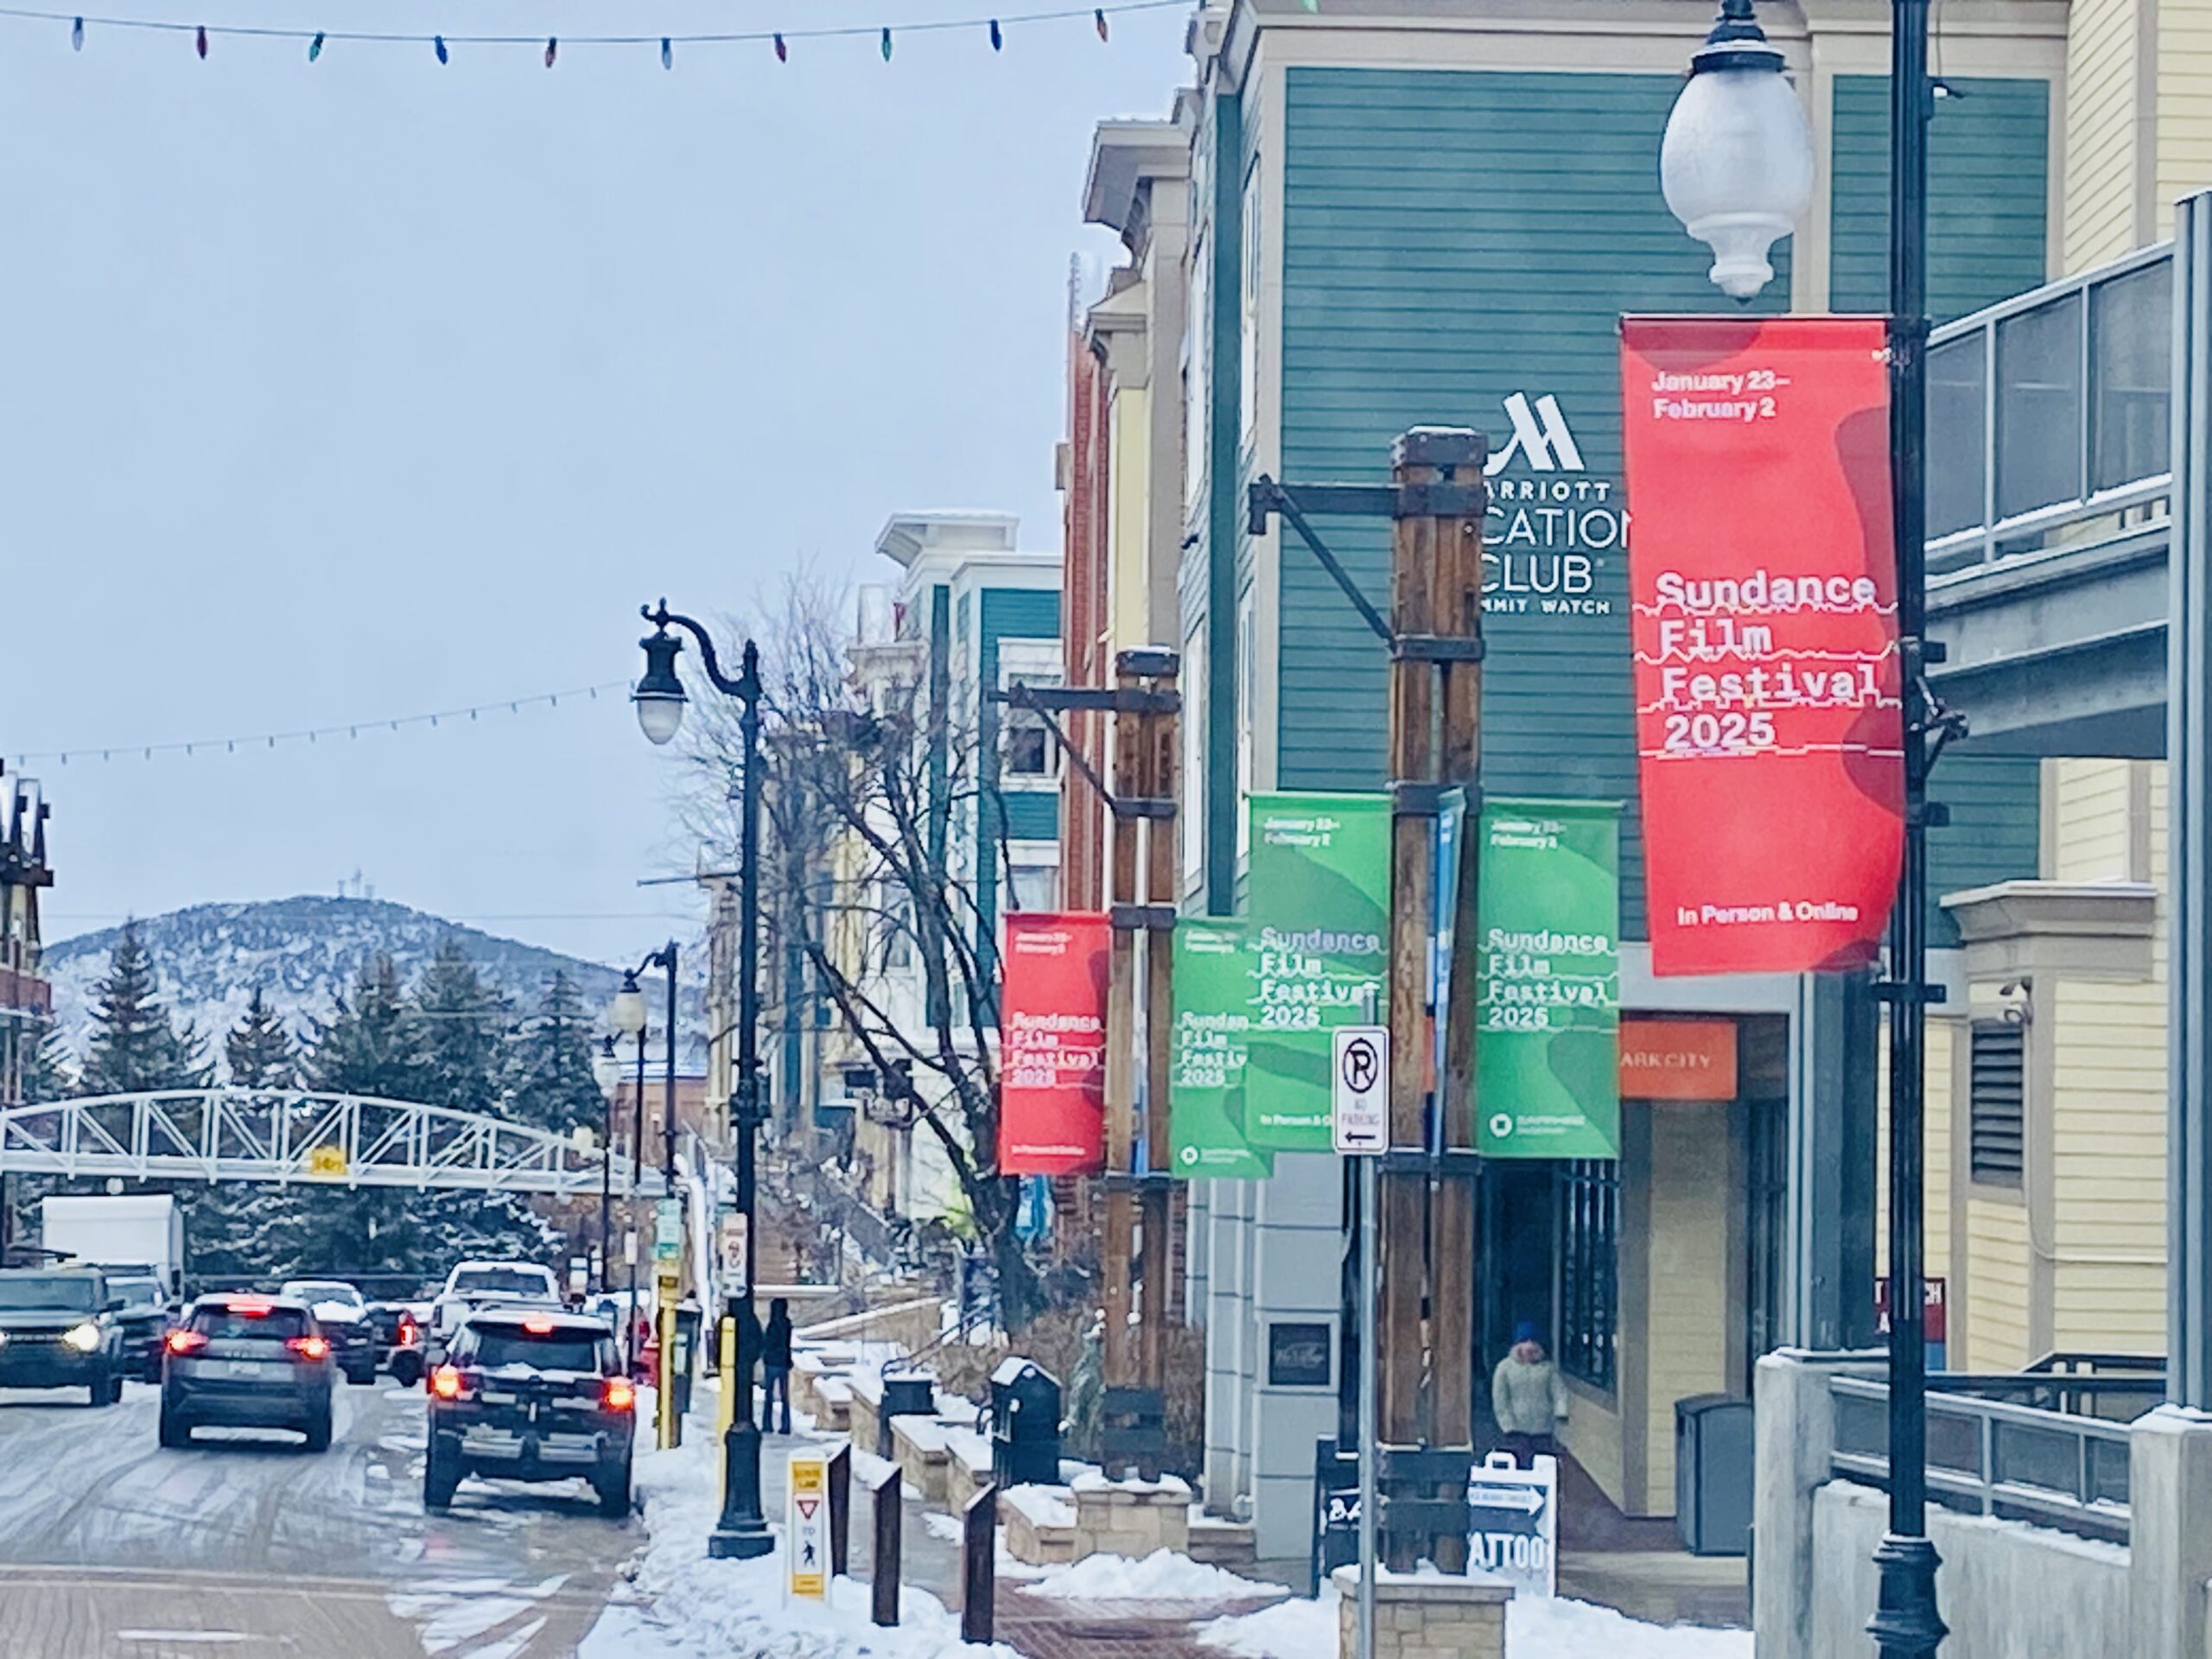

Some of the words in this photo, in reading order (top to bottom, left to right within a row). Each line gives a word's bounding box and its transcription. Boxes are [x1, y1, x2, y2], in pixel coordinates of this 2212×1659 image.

[1651, 371, 1744, 395] January
[1654, 397, 1758, 422] February
[1759, 397, 1777, 417] 2
[1481, 553, 1592, 593] CLUB
[1656, 569, 1877, 607] Sundance
[1541, 599, 1611, 614] WATCH
[1661, 619, 1771, 655] Film
[1662, 662, 1875, 702] Festival
[1664, 712, 1776, 750] 2025
[1677, 906, 1698, 925] In
[1701, 905, 1775, 924] Person
[1777, 901, 1794, 921] &
[1796, 901, 1859, 921] Online
[1261, 926, 1380, 951] Sundance
[1489, 928, 1609, 951] Sundance
[1261, 952, 1322, 976] Film
[1489, 954, 1550, 976] Film
[1261, 979, 1365, 1003] Festiva
[1489, 979, 1605, 1004] Festival
[1012, 1011, 1100, 1029] Sundance
[1261, 1005, 1320, 1027] 2025
[1489, 1007, 1548, 1027] 2025
[1012, 1030, 1058, 1048] Film
[1181, 1030, 1228, 1048] Film
[1012, 1049, 1098, 1068] Festival
[1664, 1052, 1711, 1068] CITY
[1012, 1068, 1056, 1085] 2025
[1181, 1068, 1225, 1086] 2025
